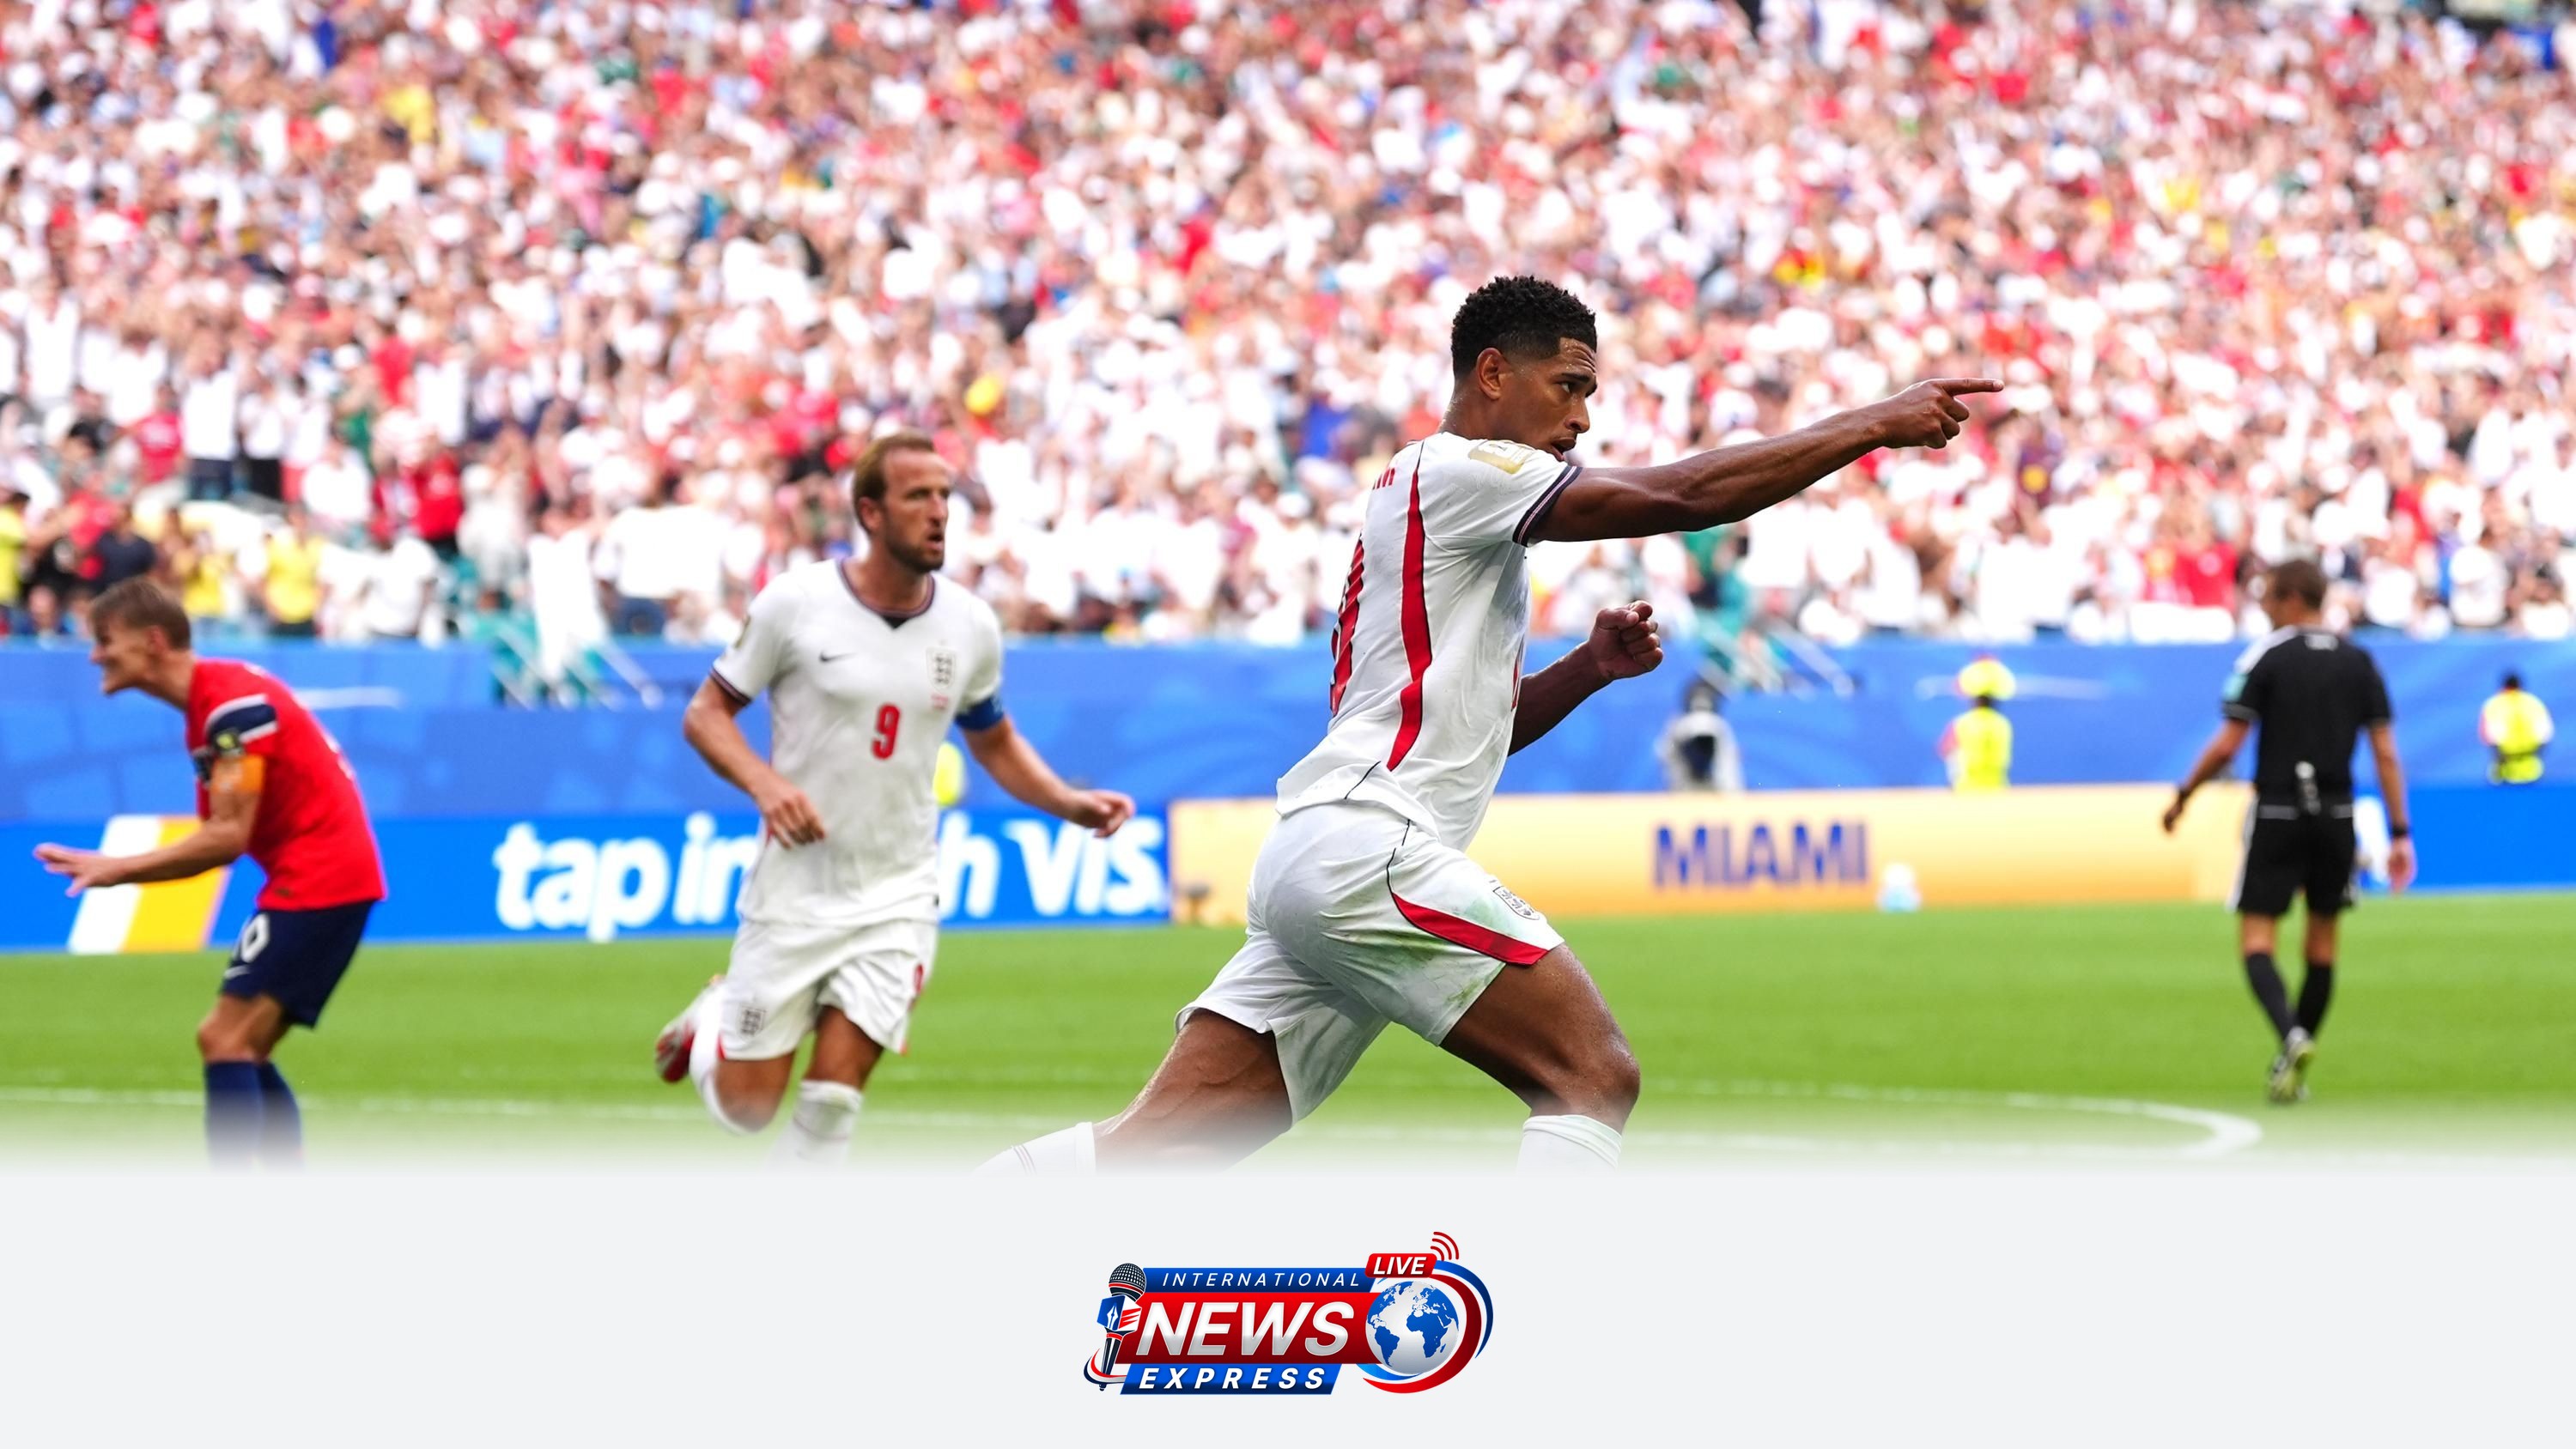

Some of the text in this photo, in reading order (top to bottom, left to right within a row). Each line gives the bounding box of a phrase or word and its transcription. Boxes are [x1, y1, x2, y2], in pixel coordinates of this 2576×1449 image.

[872, 703, 900, 760] 9
[493, 822, 670, 942] tap
[1001, 816, 1169, 915] VIS
[1656, 822, 1867, 884] MIAMI
